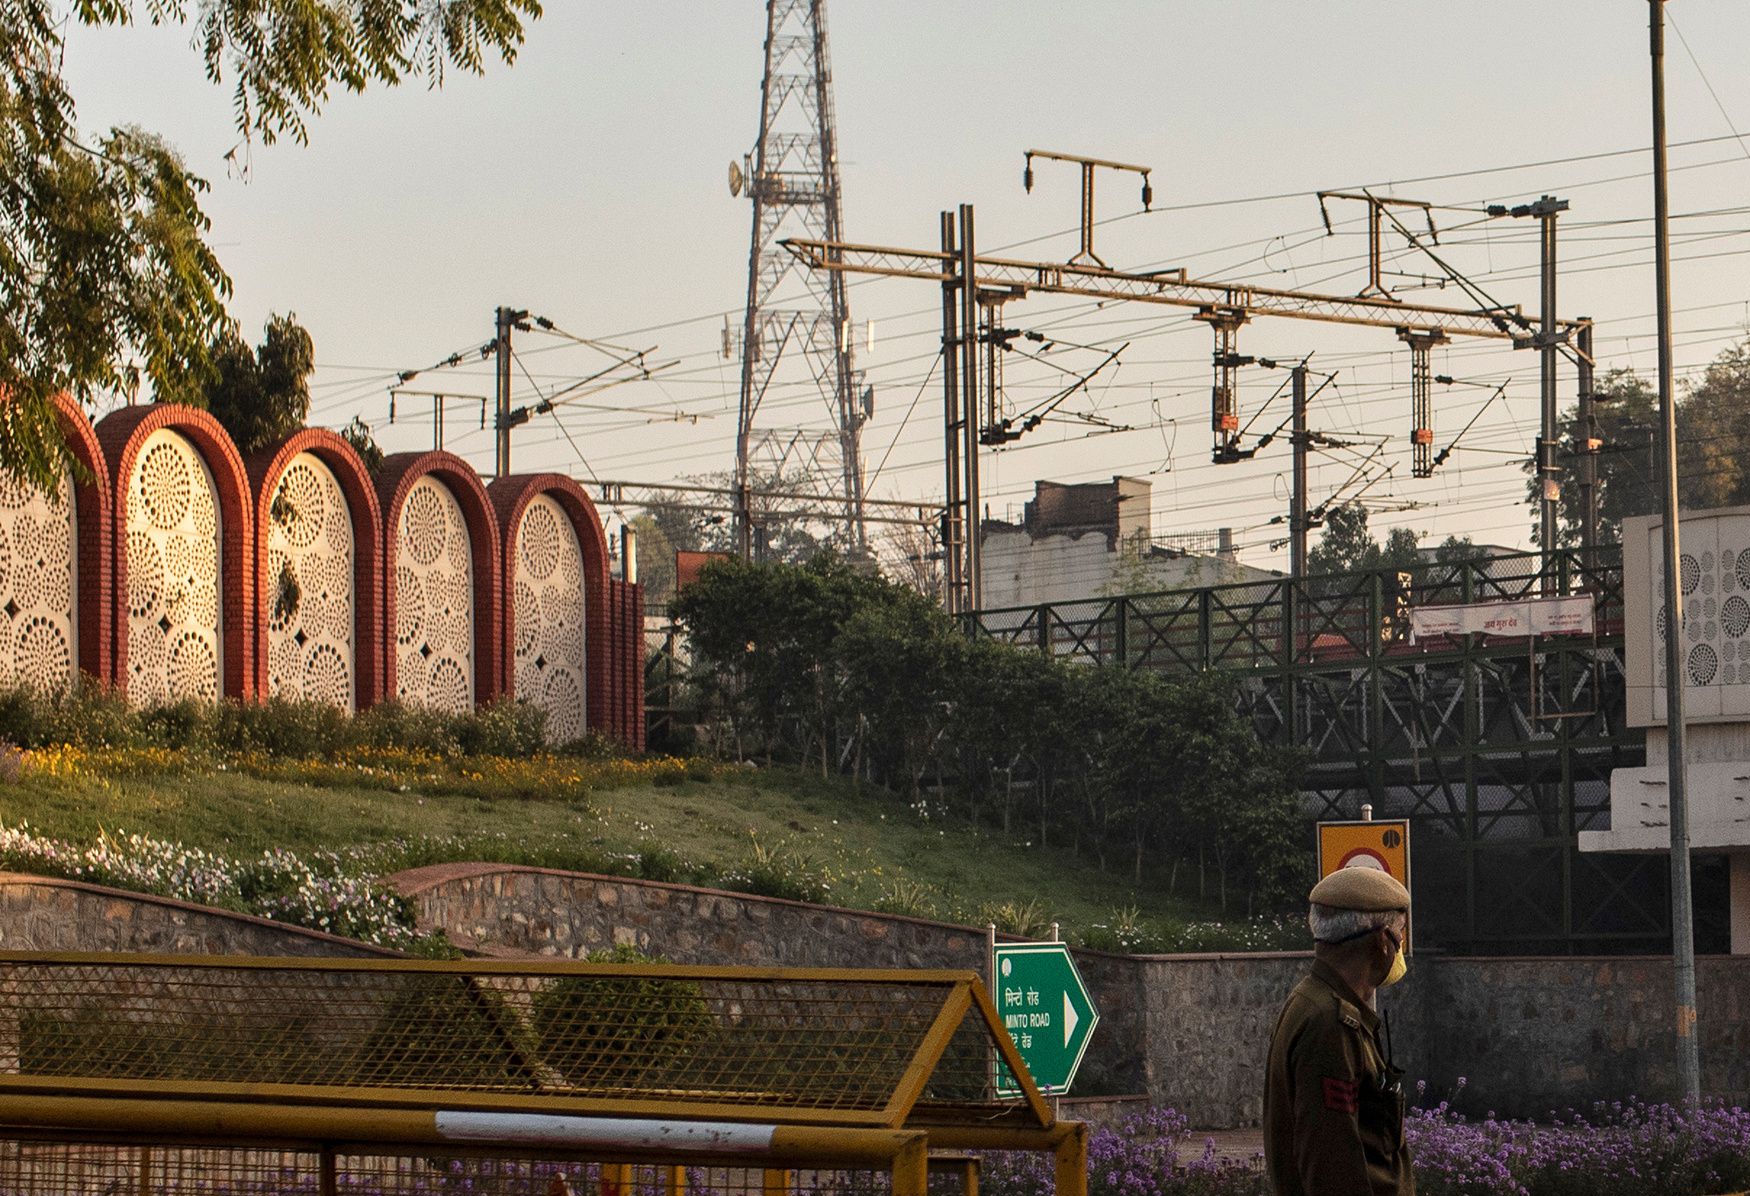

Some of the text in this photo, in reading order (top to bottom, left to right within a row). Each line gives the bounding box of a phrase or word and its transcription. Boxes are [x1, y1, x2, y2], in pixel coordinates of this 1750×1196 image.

[1027, 986, 1040, 1006] रोड
[1005, 1013, 1050, 1028] MINTO ROAD
